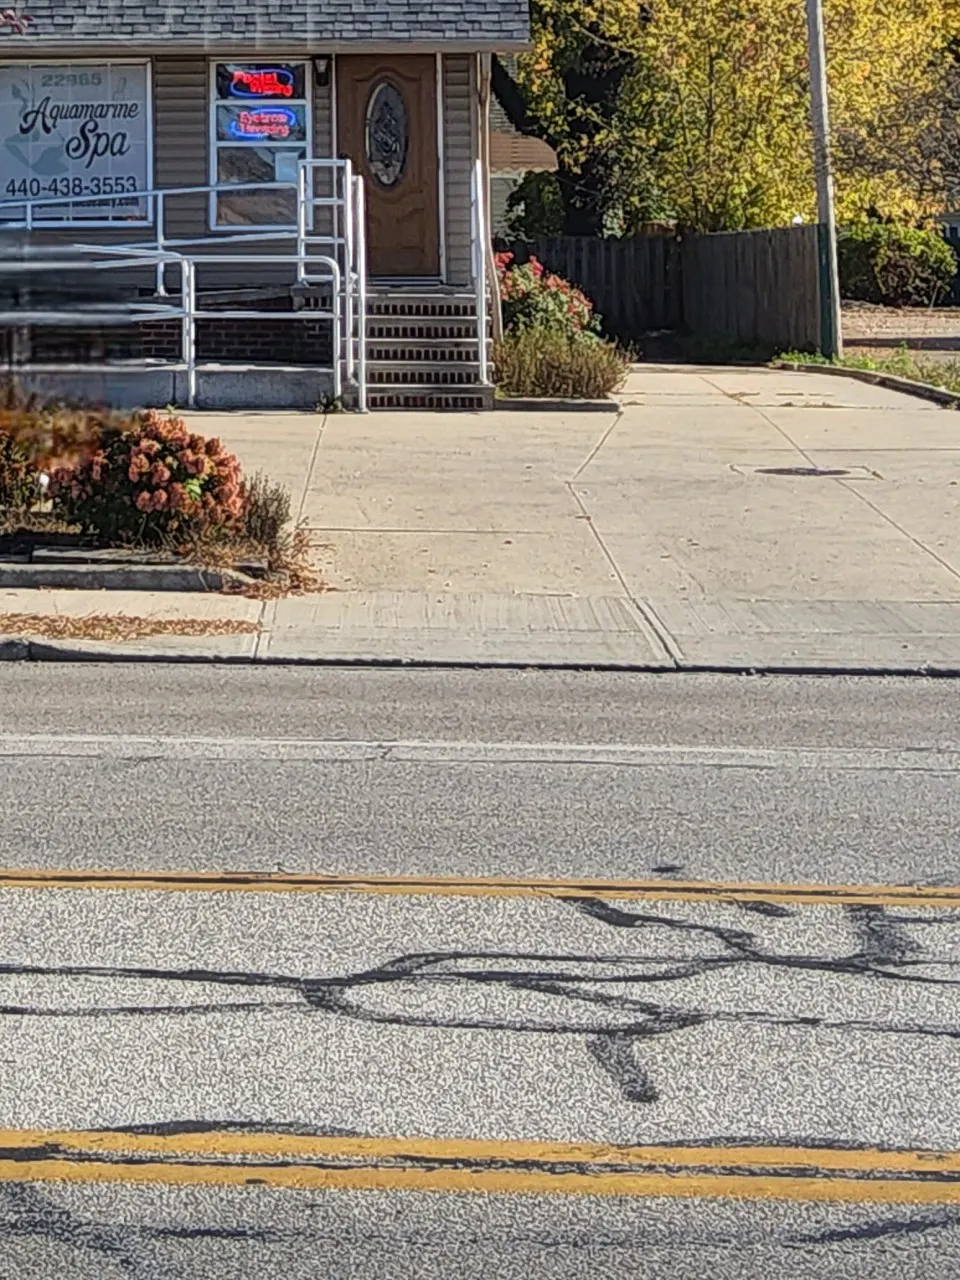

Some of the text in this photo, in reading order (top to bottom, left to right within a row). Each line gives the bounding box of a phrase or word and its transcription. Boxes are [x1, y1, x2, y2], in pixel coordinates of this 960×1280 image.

[19, 96, 139, 135] Aquamarine
[65, 120, 131, 169] Spa
[6, 176, 137, 197] 440-438-3553
